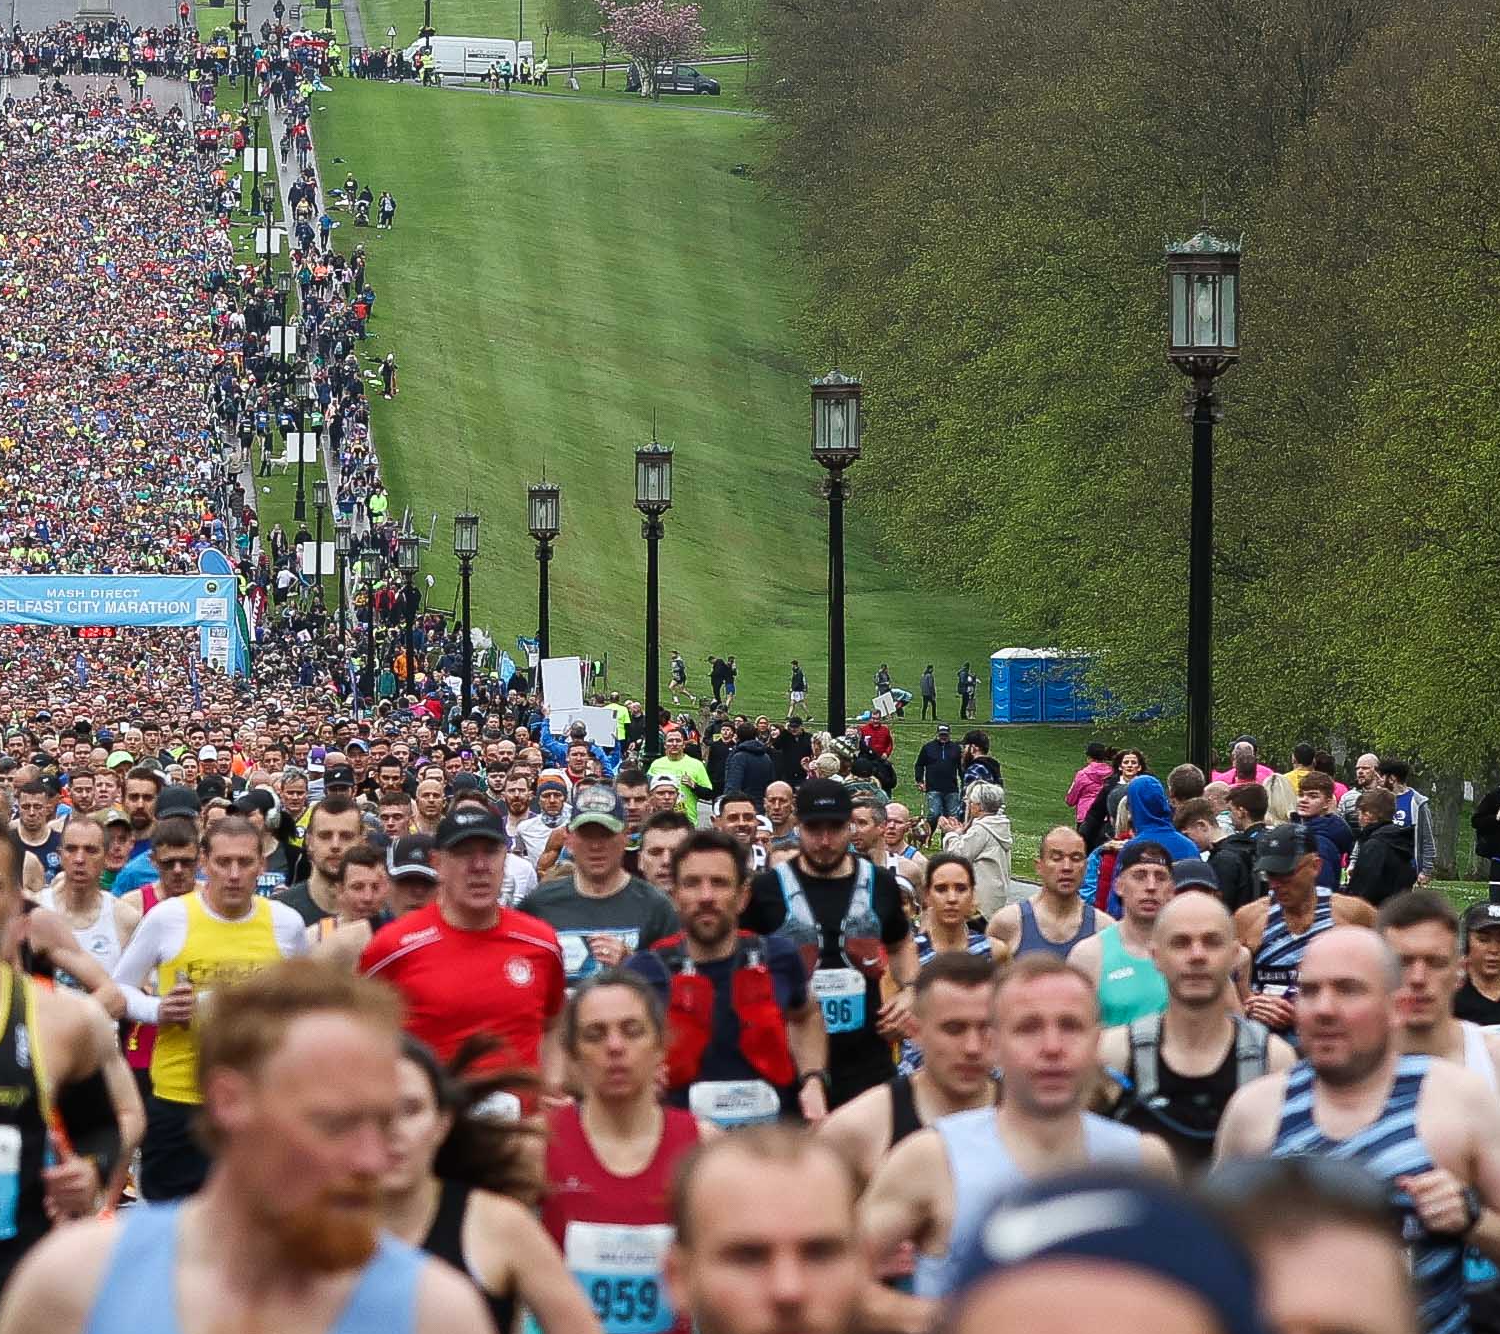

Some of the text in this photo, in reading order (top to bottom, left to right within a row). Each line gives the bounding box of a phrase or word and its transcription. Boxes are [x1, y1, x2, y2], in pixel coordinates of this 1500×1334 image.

[46, 588, 140, 598] MASH DIRECT
[67, 600, 100, 614] CITY
[104, 601, 191, 614] MARATHON
[591, 1278, 659, 1322] 959
